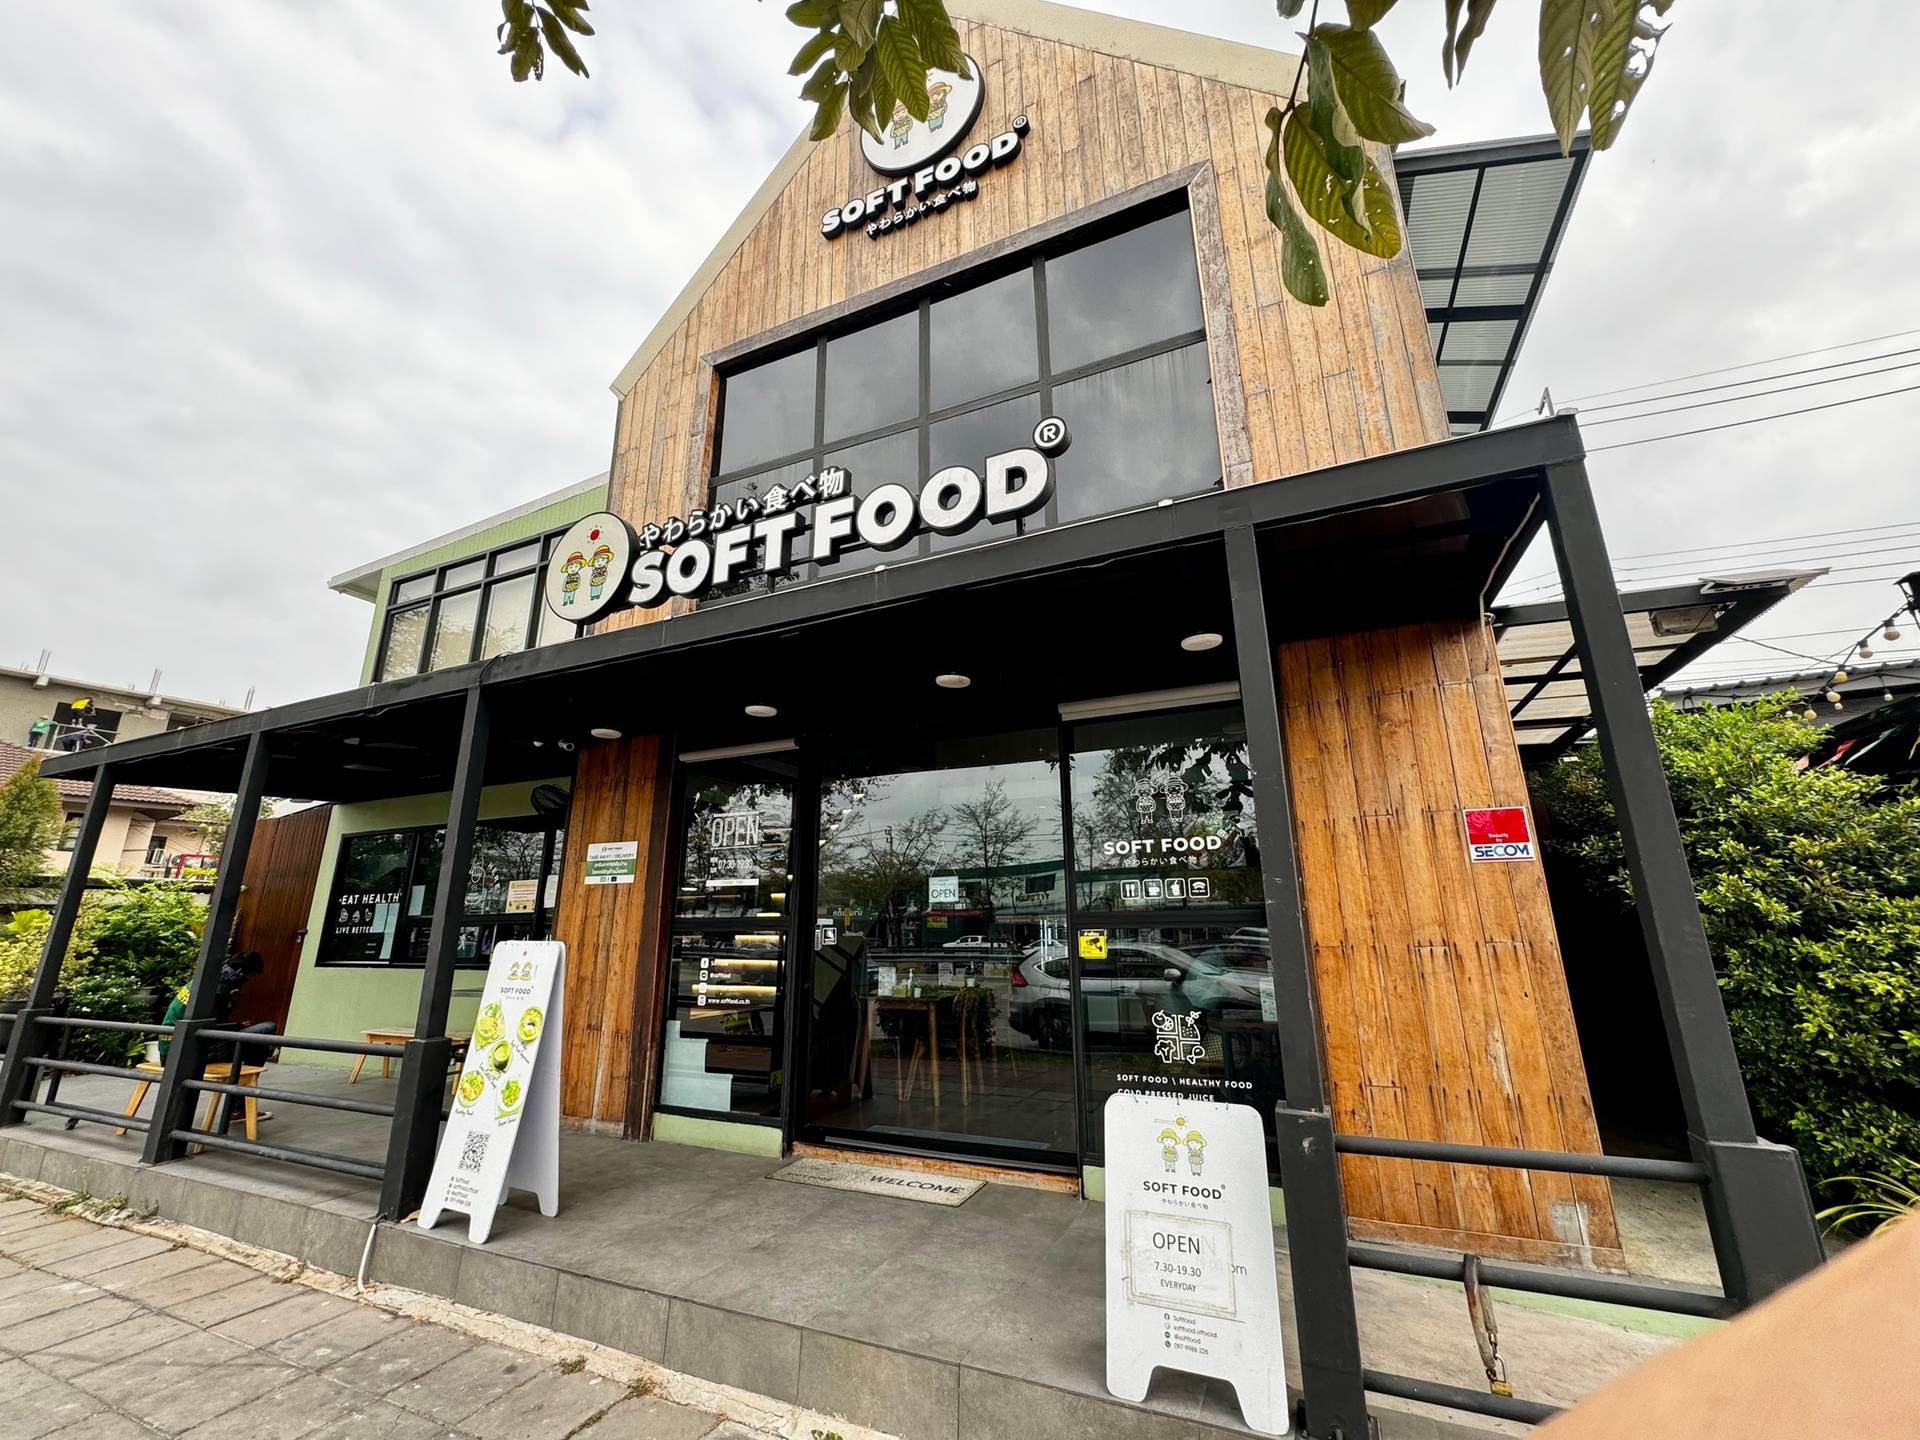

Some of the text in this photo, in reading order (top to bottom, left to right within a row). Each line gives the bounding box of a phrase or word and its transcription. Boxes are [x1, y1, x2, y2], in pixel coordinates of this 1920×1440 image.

[821, 177, 909, 234] SOFT
[914, 131, 1020, 194] FOOD
[866, 180, 977, 236] やわらかい食べ物
[639, 468, 845, 548] やわらかい食べ物
[628, 513, 797, 606] SOFT
[812, 447, 1051, 562] FOOD
[711, 815, 760, 847] OPEN
[1103, 835, 1222, 856] SOFT FOOD
[1474, 844, 1530, 858] SECOM
[1123, 855, 1198, 867] やわらかい食べ物
[341, 894, 360, 905] EAT
[931, 888, 956, 898] OPEN
[335, 926, 350, 934] LIVE
[1116, 1073, 1140, 1082] SOFT
[1142, 1075, 1168, 1084] FOOD
[1179, 1077, 1221, 1088] HEALTHY
[1224, 1080, 1253, 1090] FOOD
[1145, 1089, 1184, 1100] PRESSED
[1187, 1093, 1215, 1102] JUICE
[870, 1174, 965, 1195] WELCOME
[1143, 1180, 1222, 1200] SOFT FOOD
[1152, 1231, 1201, 1255] OPEN
[1154, 1261, 1202, 1278] 7.30-19.30
[1160, 1279, 1197, 1292] EVERYDAY
